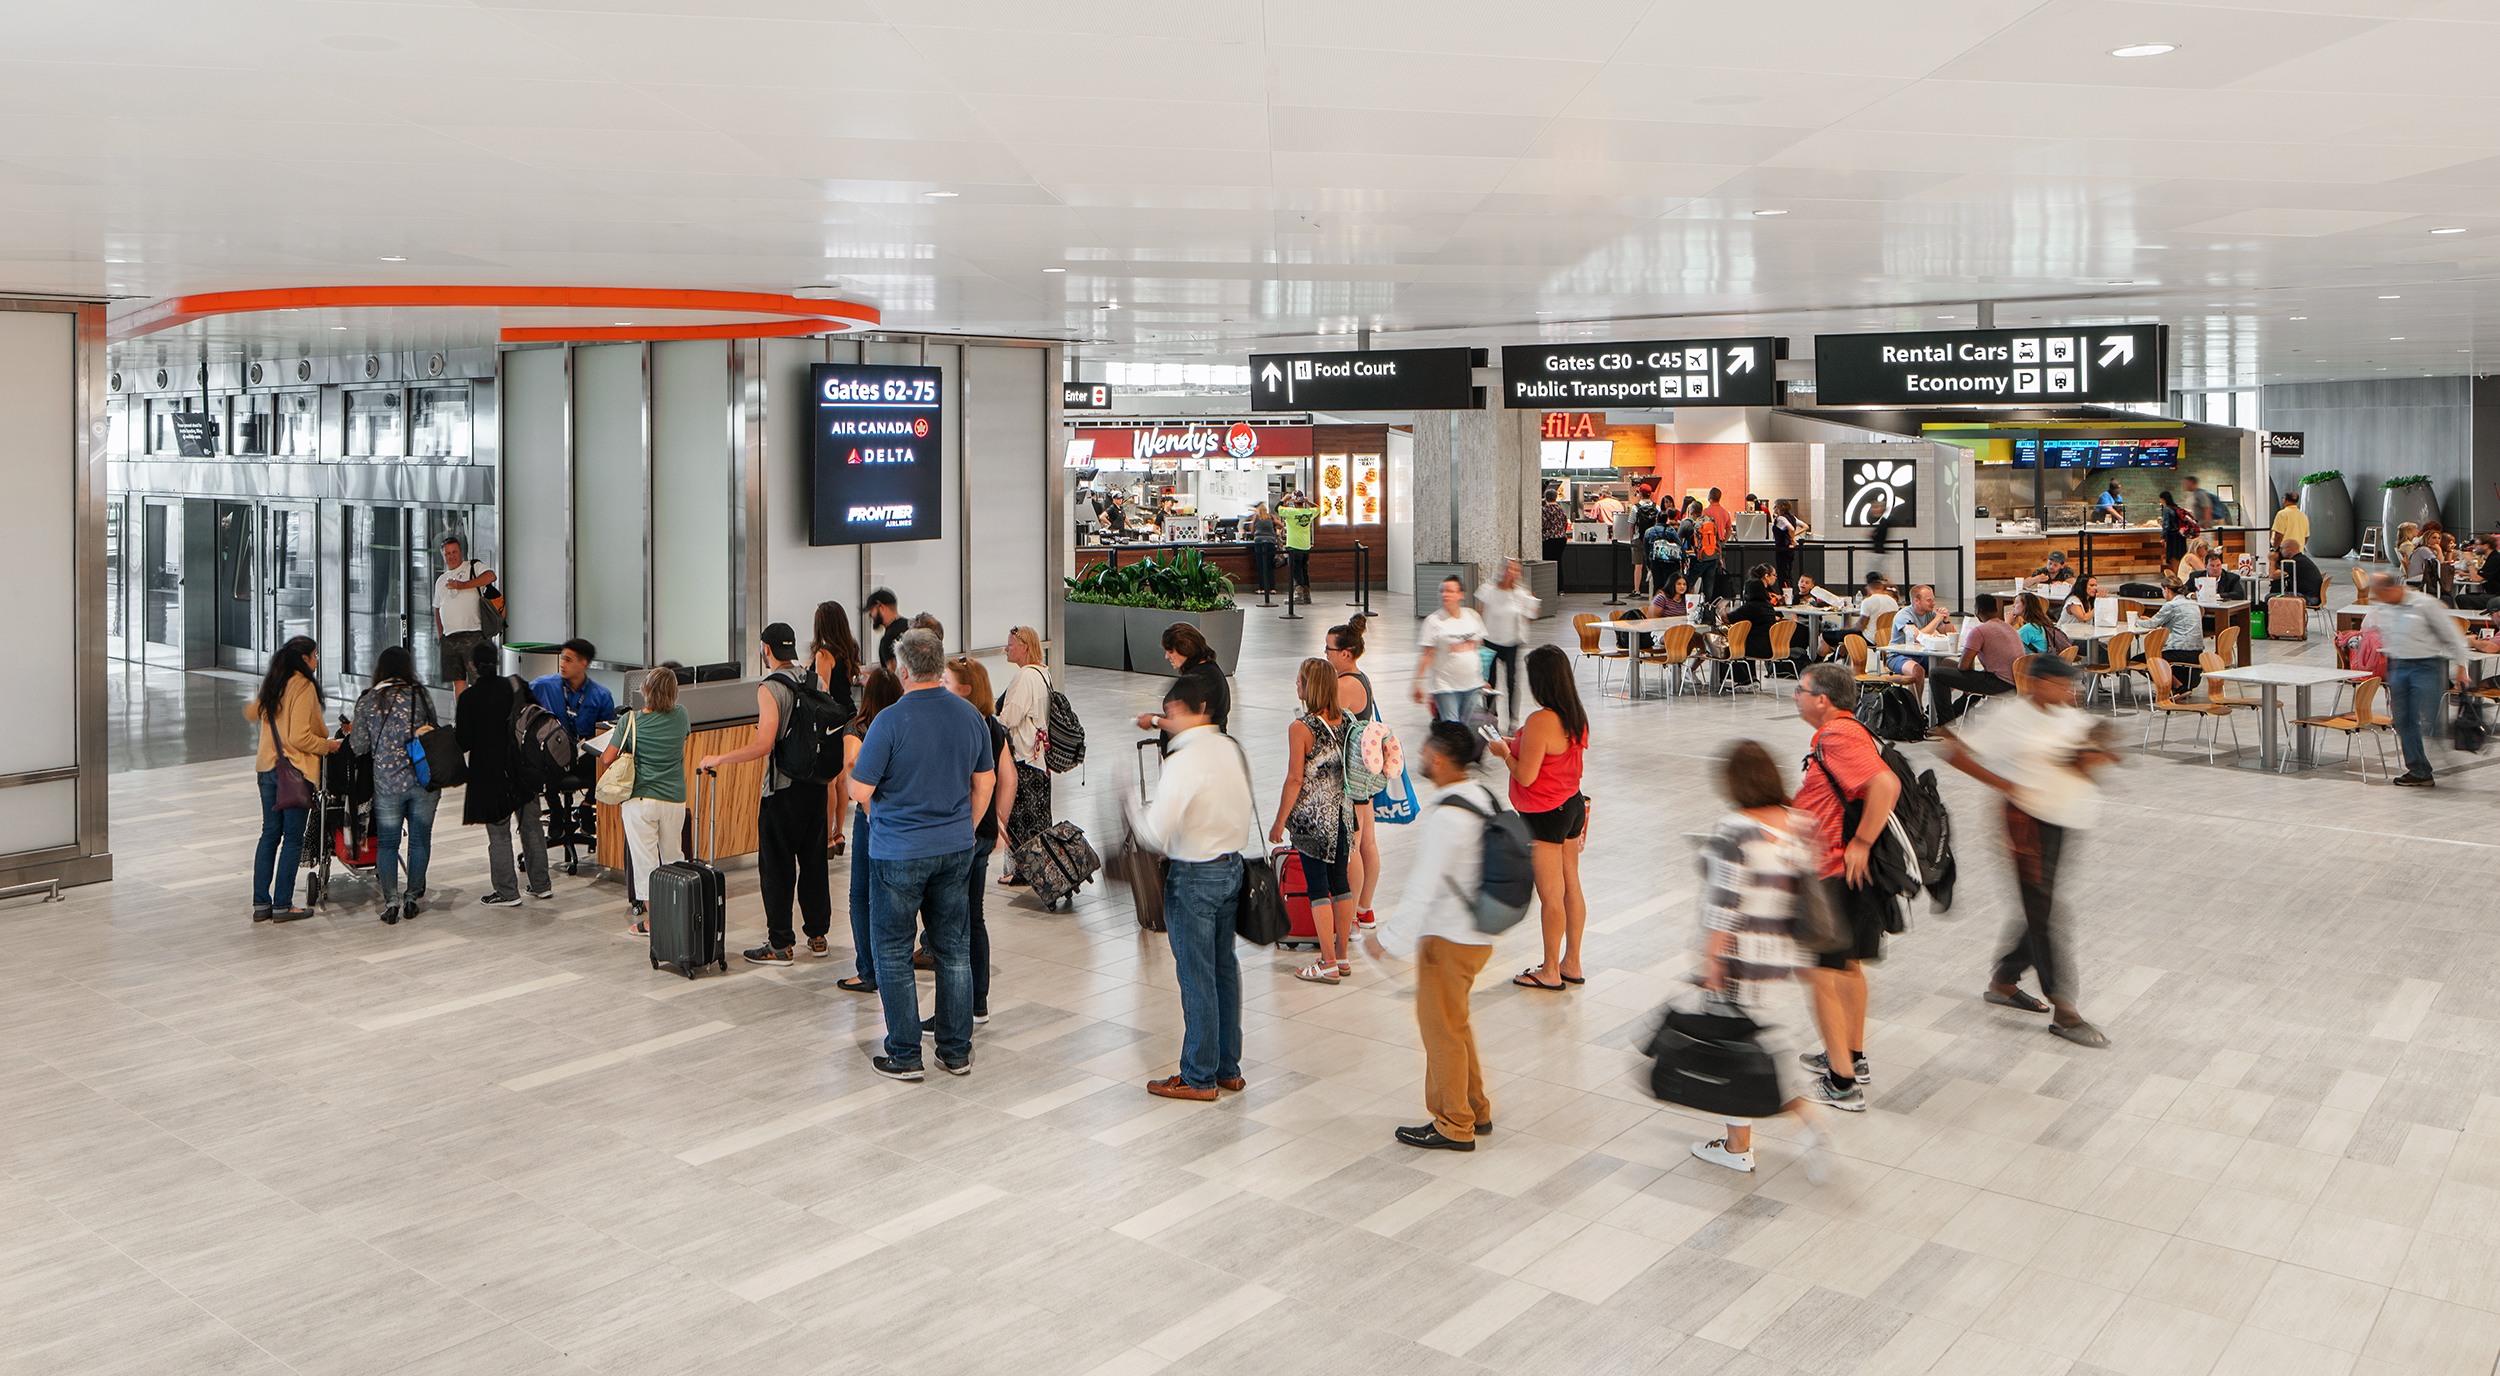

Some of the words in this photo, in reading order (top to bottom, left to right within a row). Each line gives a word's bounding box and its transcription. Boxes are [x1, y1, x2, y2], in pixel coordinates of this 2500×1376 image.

[1545, 355, 1595, 372] Gates
[1599, 354, 1632, 370] C30
[1648, 352, 1682, 369] C45
[1882, 343, 1952, 363] Rental
[1959, 343, 2008, 361] Cars
[1315, 361, 1350, 377] Food
[1354, 361, 1396, 376] Court
[824, 378, 880, 401] Gates
[884, 379, 935, 401] 62-75
[1516, 381, 1568, 398] Public
[1571, 380, 1657, 399] Transport
[1906, 374, 2009, 394] Economy
[1065, 389, 1088, 402] Enter
[832, 421, 856, 435] AIR
[858, 421, 914, 435] CANADA
[1540, 412, 1596, 438] -fil-A
[1133, 422, 1219, 459] Wendy's
[864, 448, 915, 462] DELTA
[848, 505, 913, 522] FRONTIER
